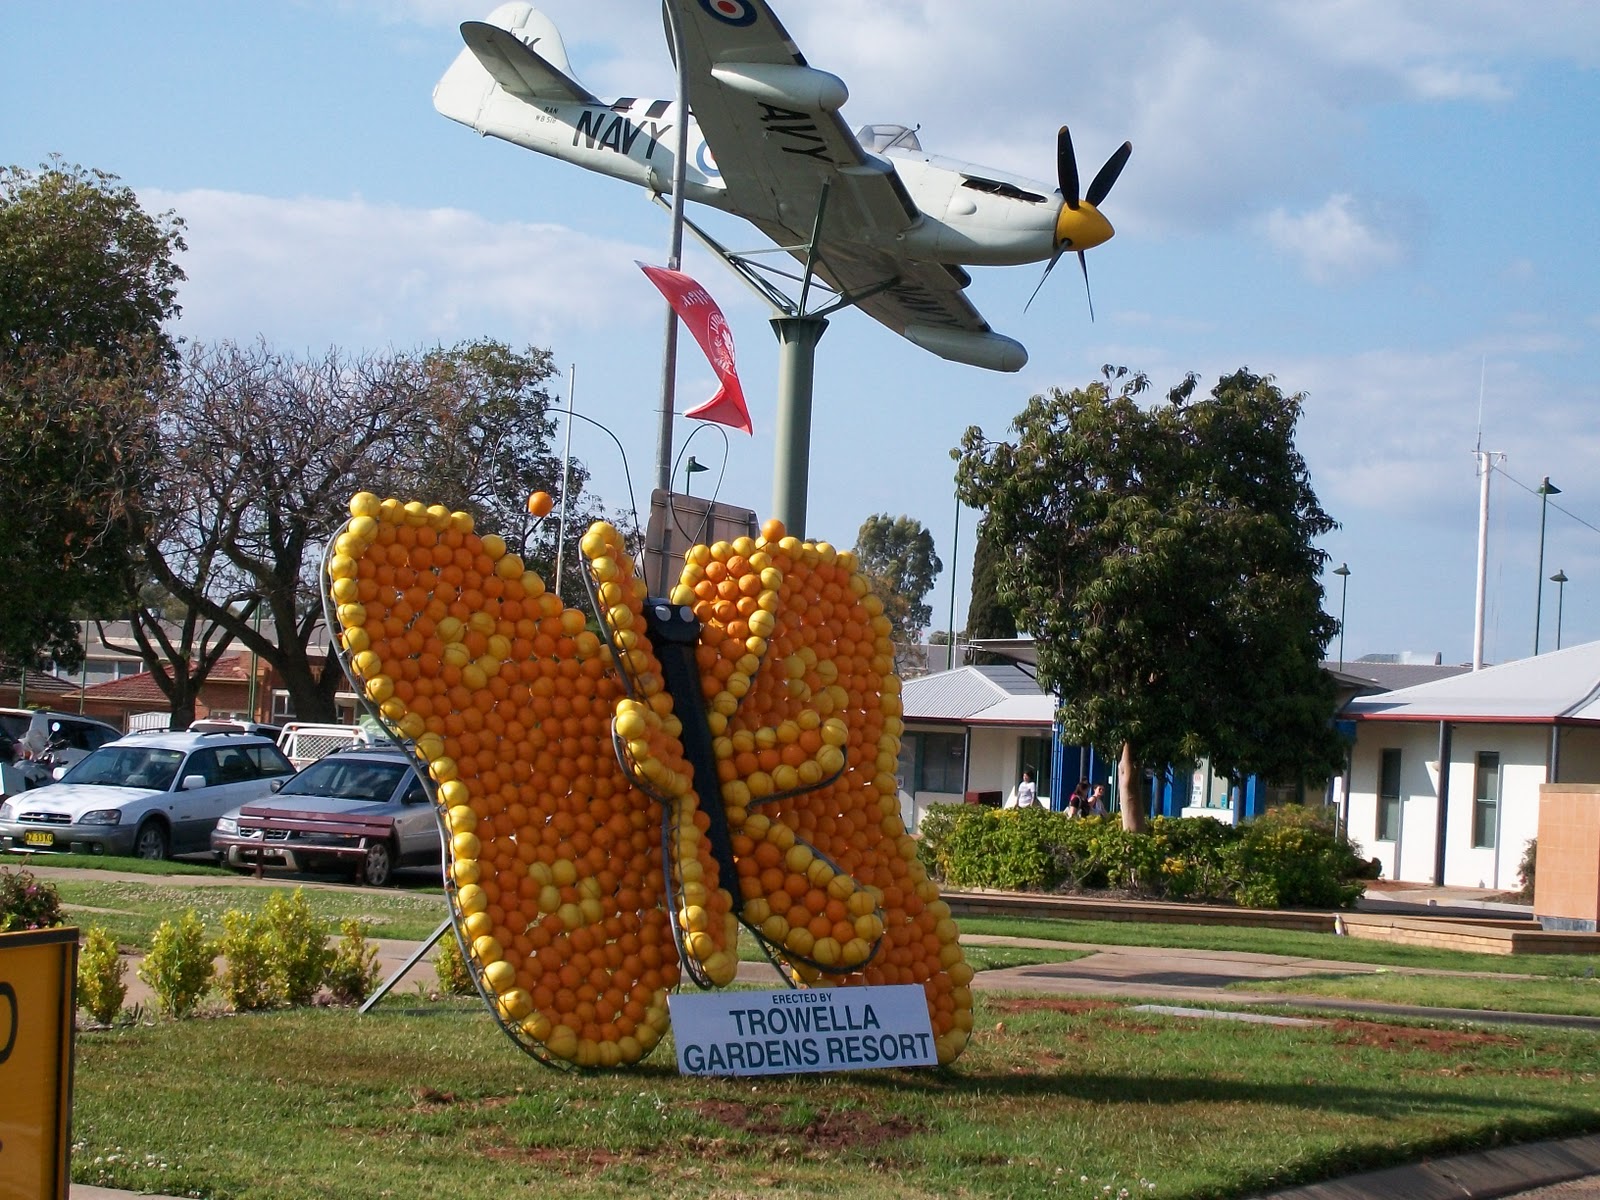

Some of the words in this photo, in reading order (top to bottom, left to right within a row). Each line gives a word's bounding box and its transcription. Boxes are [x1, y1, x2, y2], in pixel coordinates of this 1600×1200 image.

[544, 106, 559, 114] RAN
[572, 110, 673, 160] NAVY
[757, 101, 835, 163] AVY
[772, 993, 817, 1005] ERECTED
[819, 992, 832, 1003] BY
[729, 1004, 881, 1036] TROWELLA
[683, 1039, 820, 1073] GARDENS
[826, 1032, 930, 1064] RESORT
